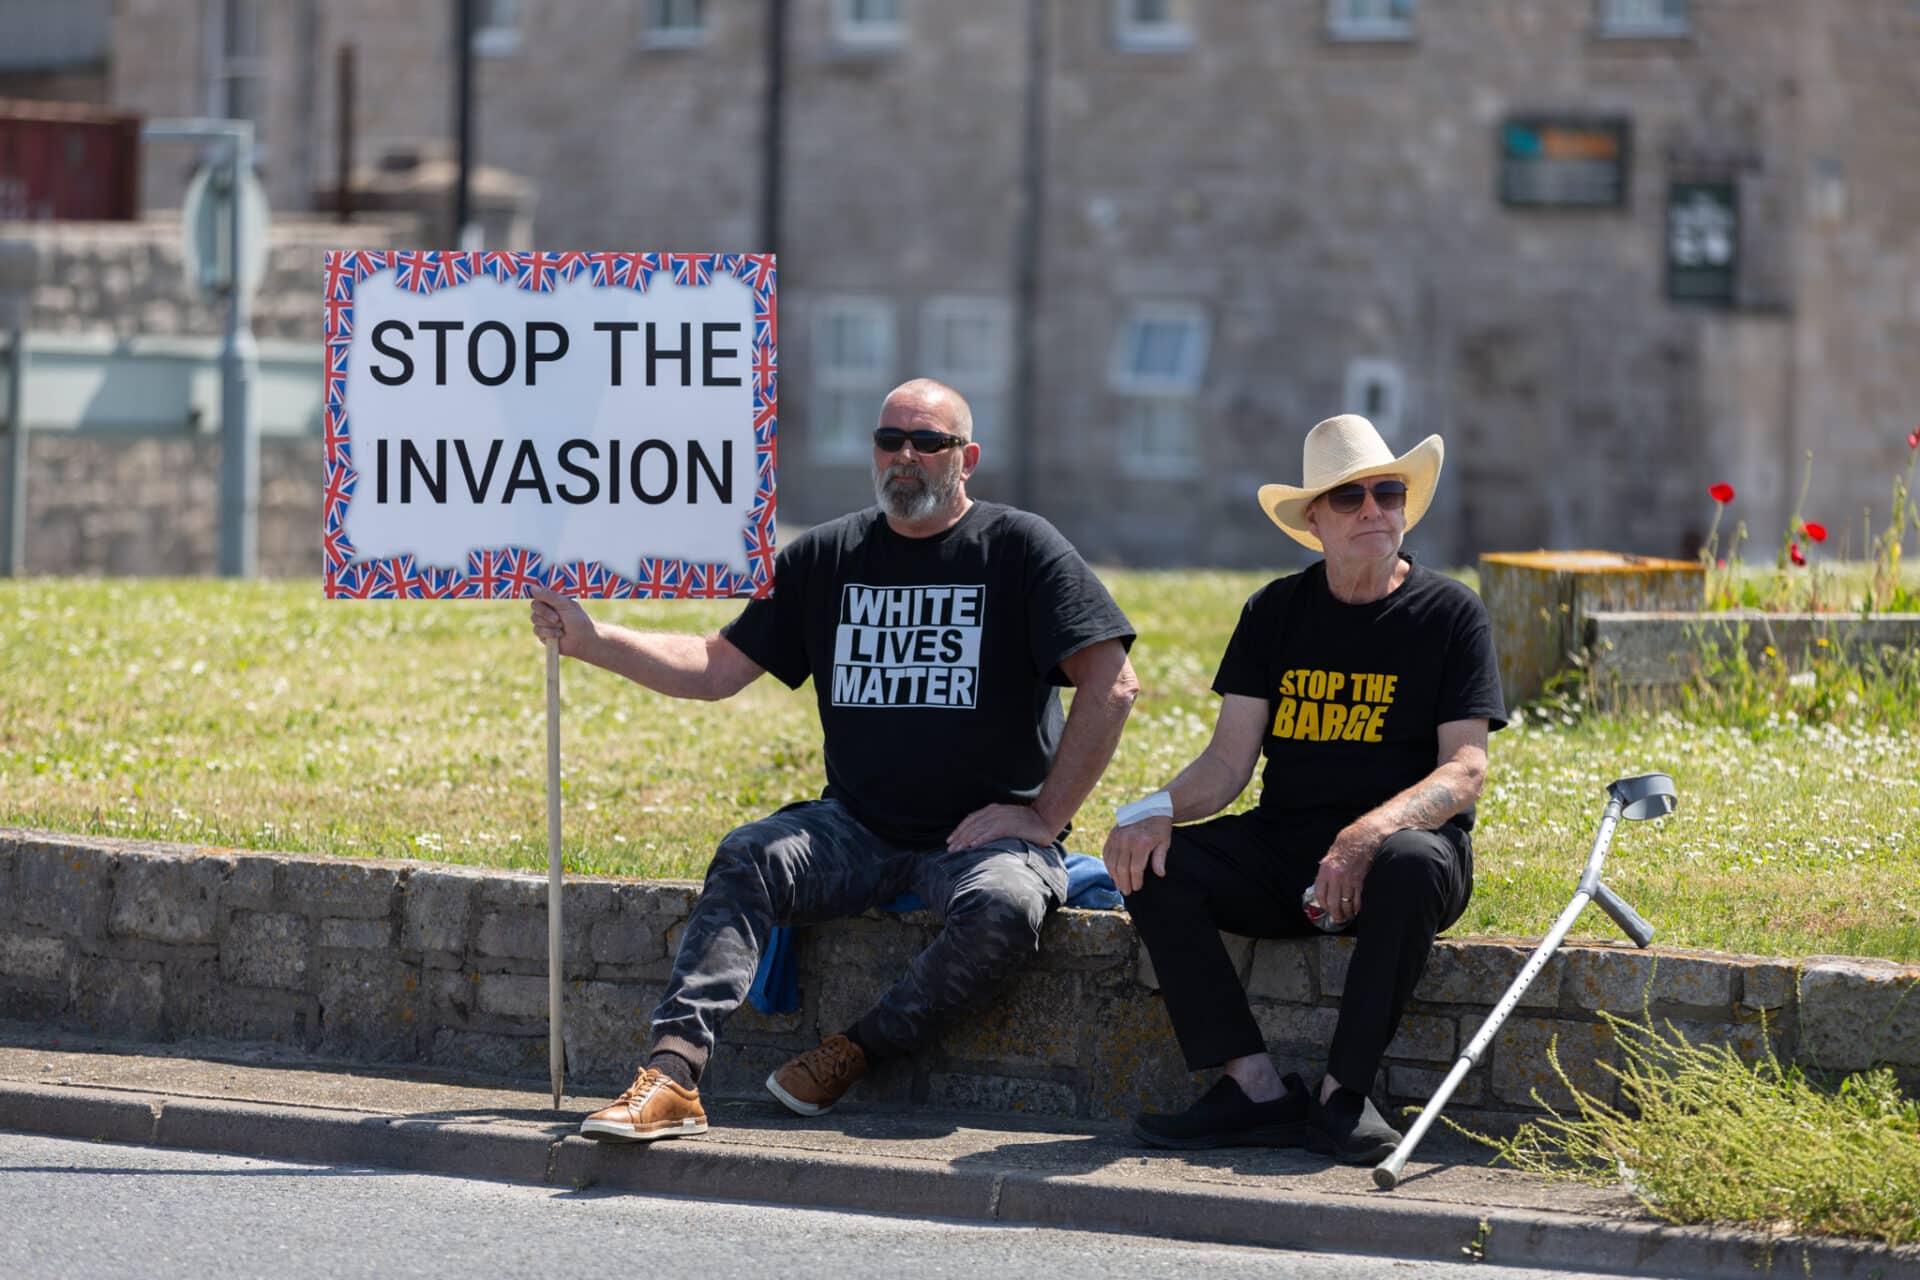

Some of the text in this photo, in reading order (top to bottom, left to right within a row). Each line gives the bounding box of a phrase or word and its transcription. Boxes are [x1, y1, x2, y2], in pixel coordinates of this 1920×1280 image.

[370, 320, 741, 386] STOP THE
[376, 439, 733, 505] INVASION
[849, 587, 978, 626] WHITE
[850, 628, 963, 663] LIVES
[834, 666, 973, 704] MATTER
[1279, 669, 1398, 703] STOP THE
[1272, 696, 1389, 742] BARGE
